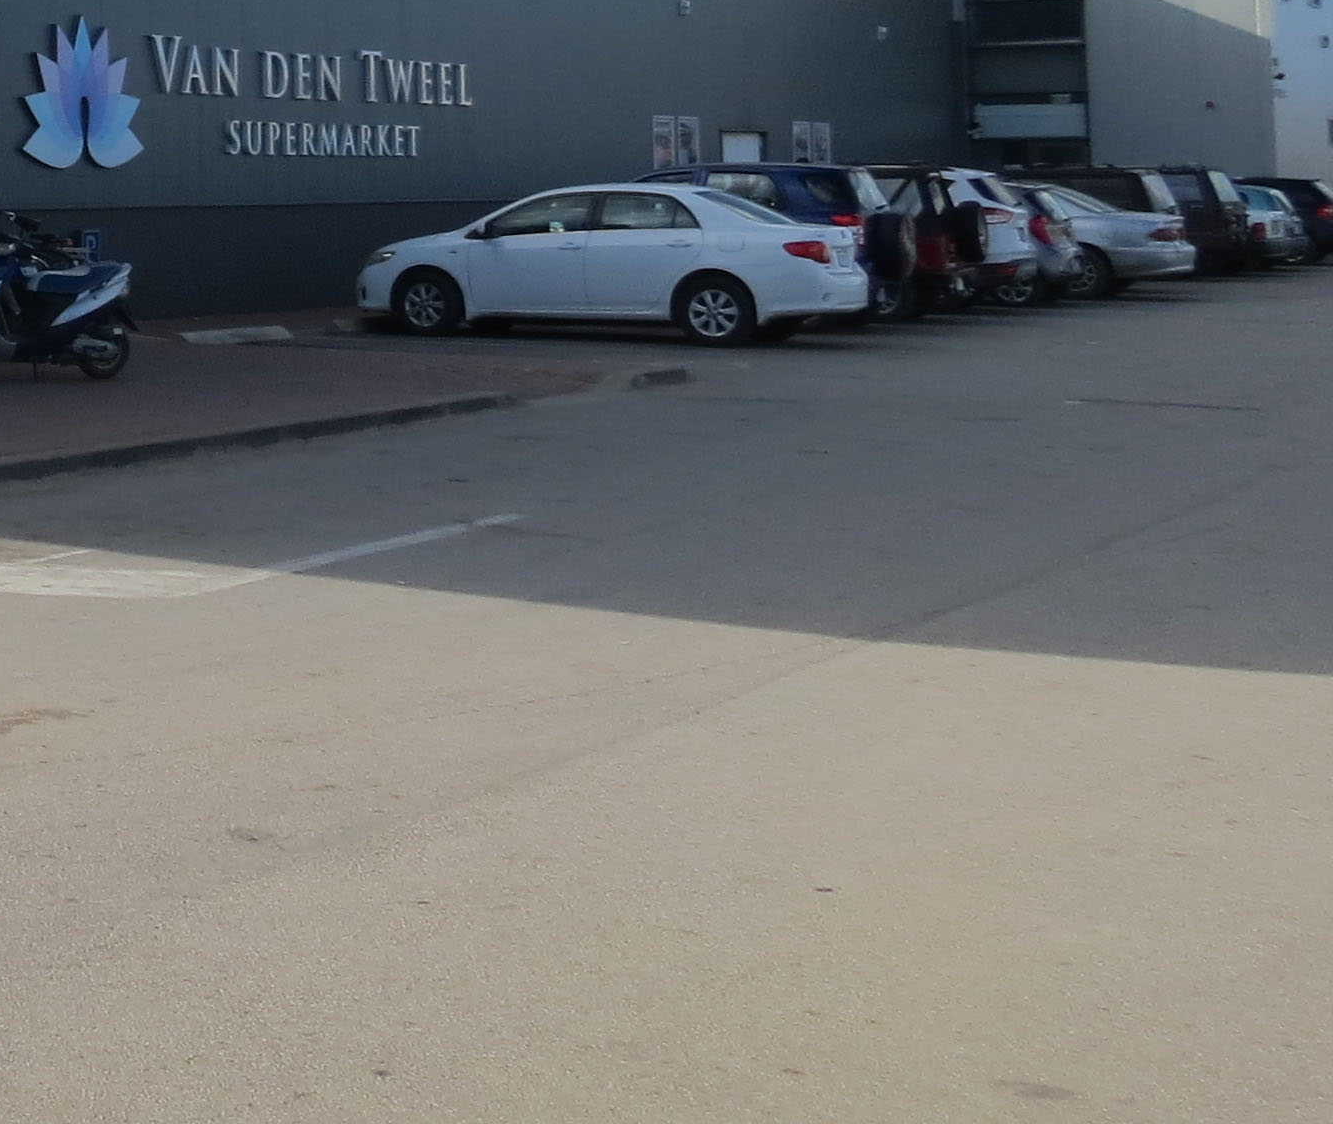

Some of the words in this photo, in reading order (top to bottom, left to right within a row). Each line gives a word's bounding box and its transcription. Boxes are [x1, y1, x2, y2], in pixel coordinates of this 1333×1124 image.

[151, 34, 239, 97] VAN
[262, 50, 341, 101] DEN
[360, 49, 473, 106] TWEEL
[228, 119, 420, 157] SUPERMARKET
